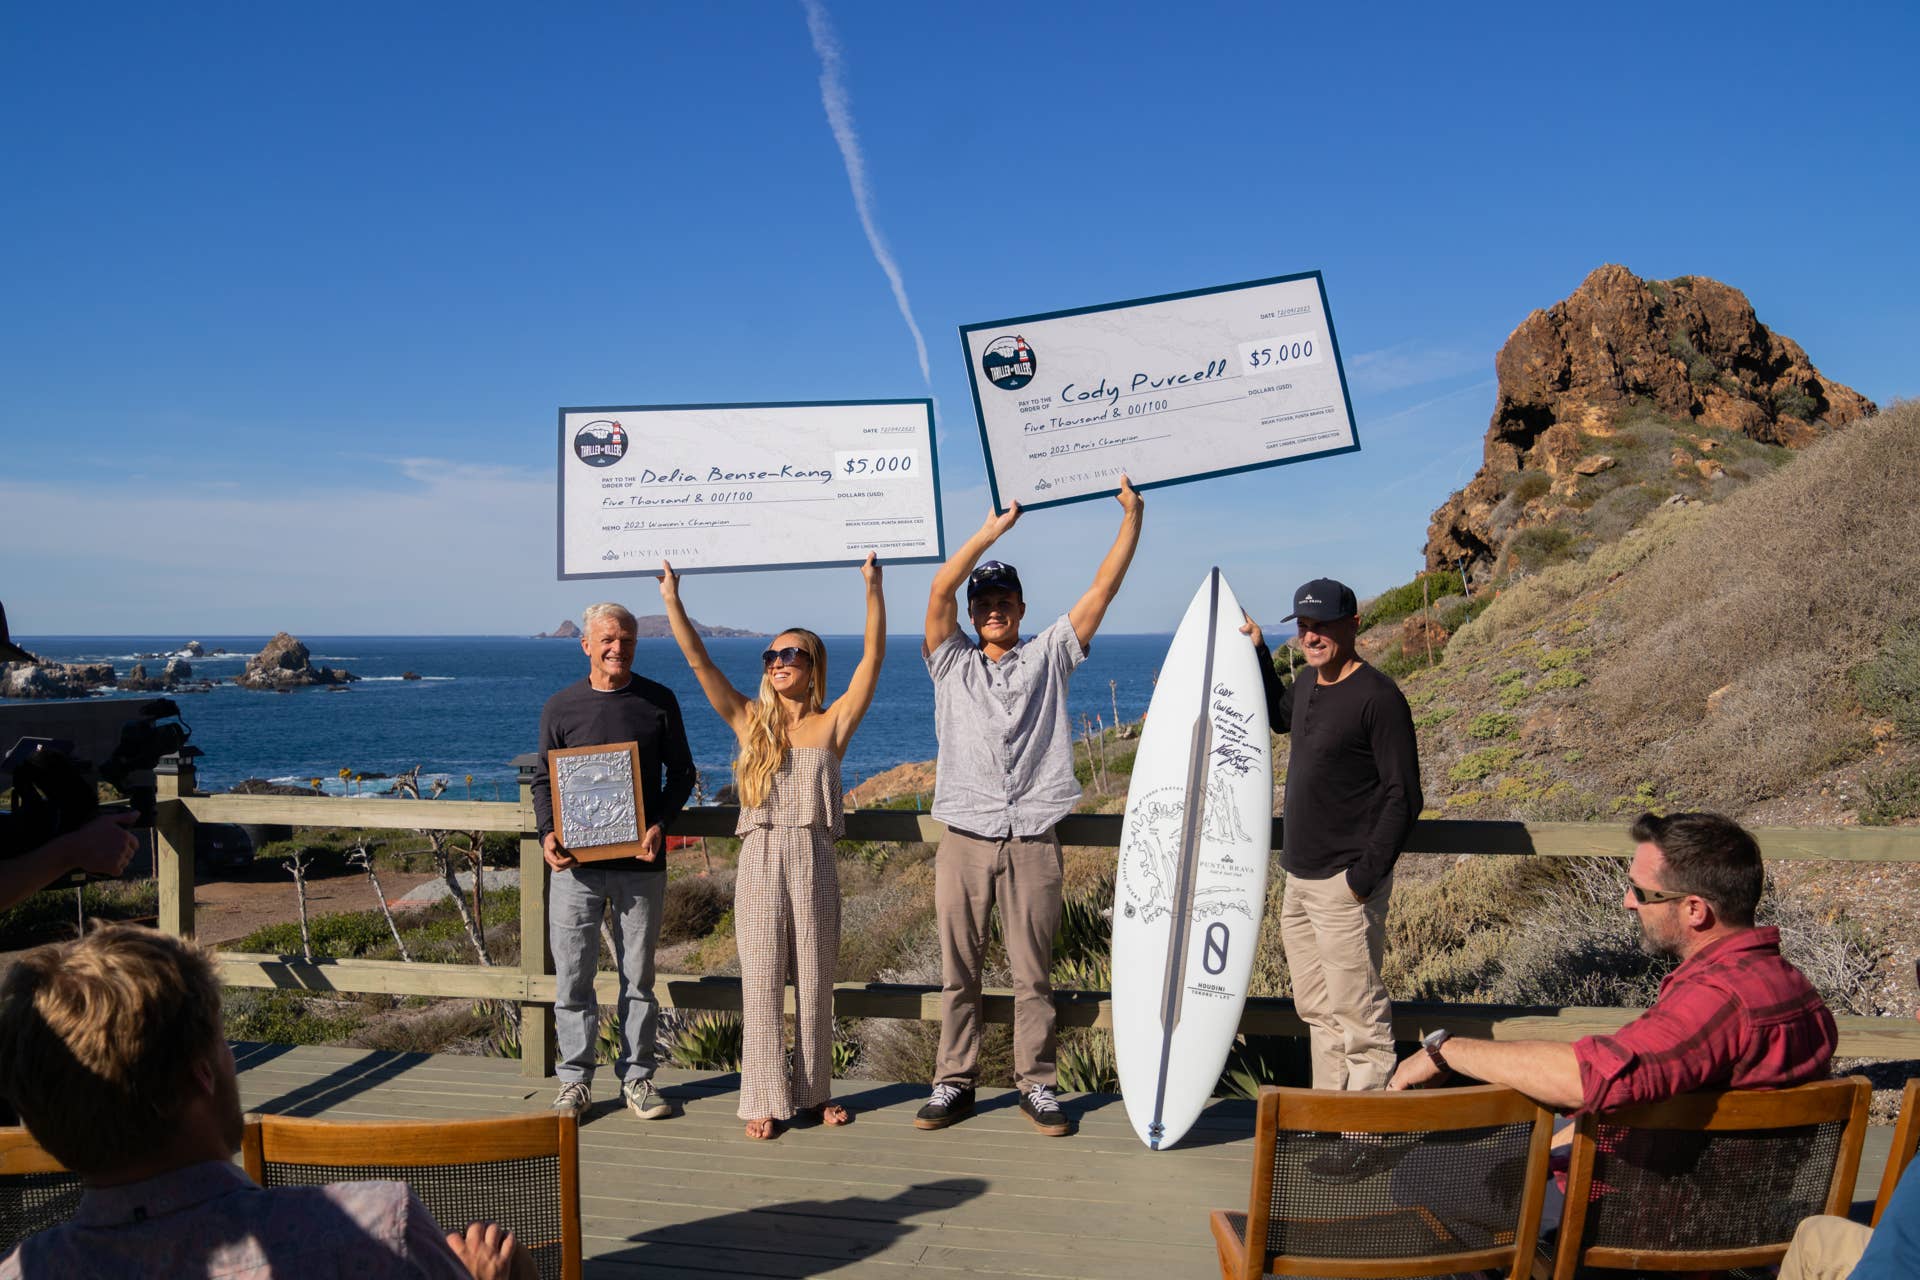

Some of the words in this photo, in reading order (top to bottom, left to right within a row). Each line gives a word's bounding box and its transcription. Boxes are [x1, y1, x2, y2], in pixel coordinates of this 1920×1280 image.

[1249, 340, 1312, 368] $5,000
[1061, 379, 1120, 406] Cody
[1131, 359, 1226, 392] Purcell
[1248, 387, 1274, 396] DOLLARS
[1050, 410, 1108, 428] Thousand
[1112, 408, 1120, 418] &
[1128, 400, 1168, 416] 00/100
[1050, 444, 1070, 454] 2023
[1099, 436, 1138, 446] Champion
[640, 468, 697, 484] Delia
[707, 465, 832, 484] Bense-Kang
[843, 456, 911, 475] $5,000
[1054, 473, 1089, 486] PUNTA
[1094, 466, 1128, 478] BRAVA
[630, 494, 690, 504] Thousand
[694, 494, 704, 502] &
[711, 492, 752, 502] 00/100
[664, 548, 700, 556] BRAVA
[1213, 682, 1234, 698] CODY
[1230, 865, 1254, 873] BRAVA
[1198, 982, 1226, 992] HOUDINI
